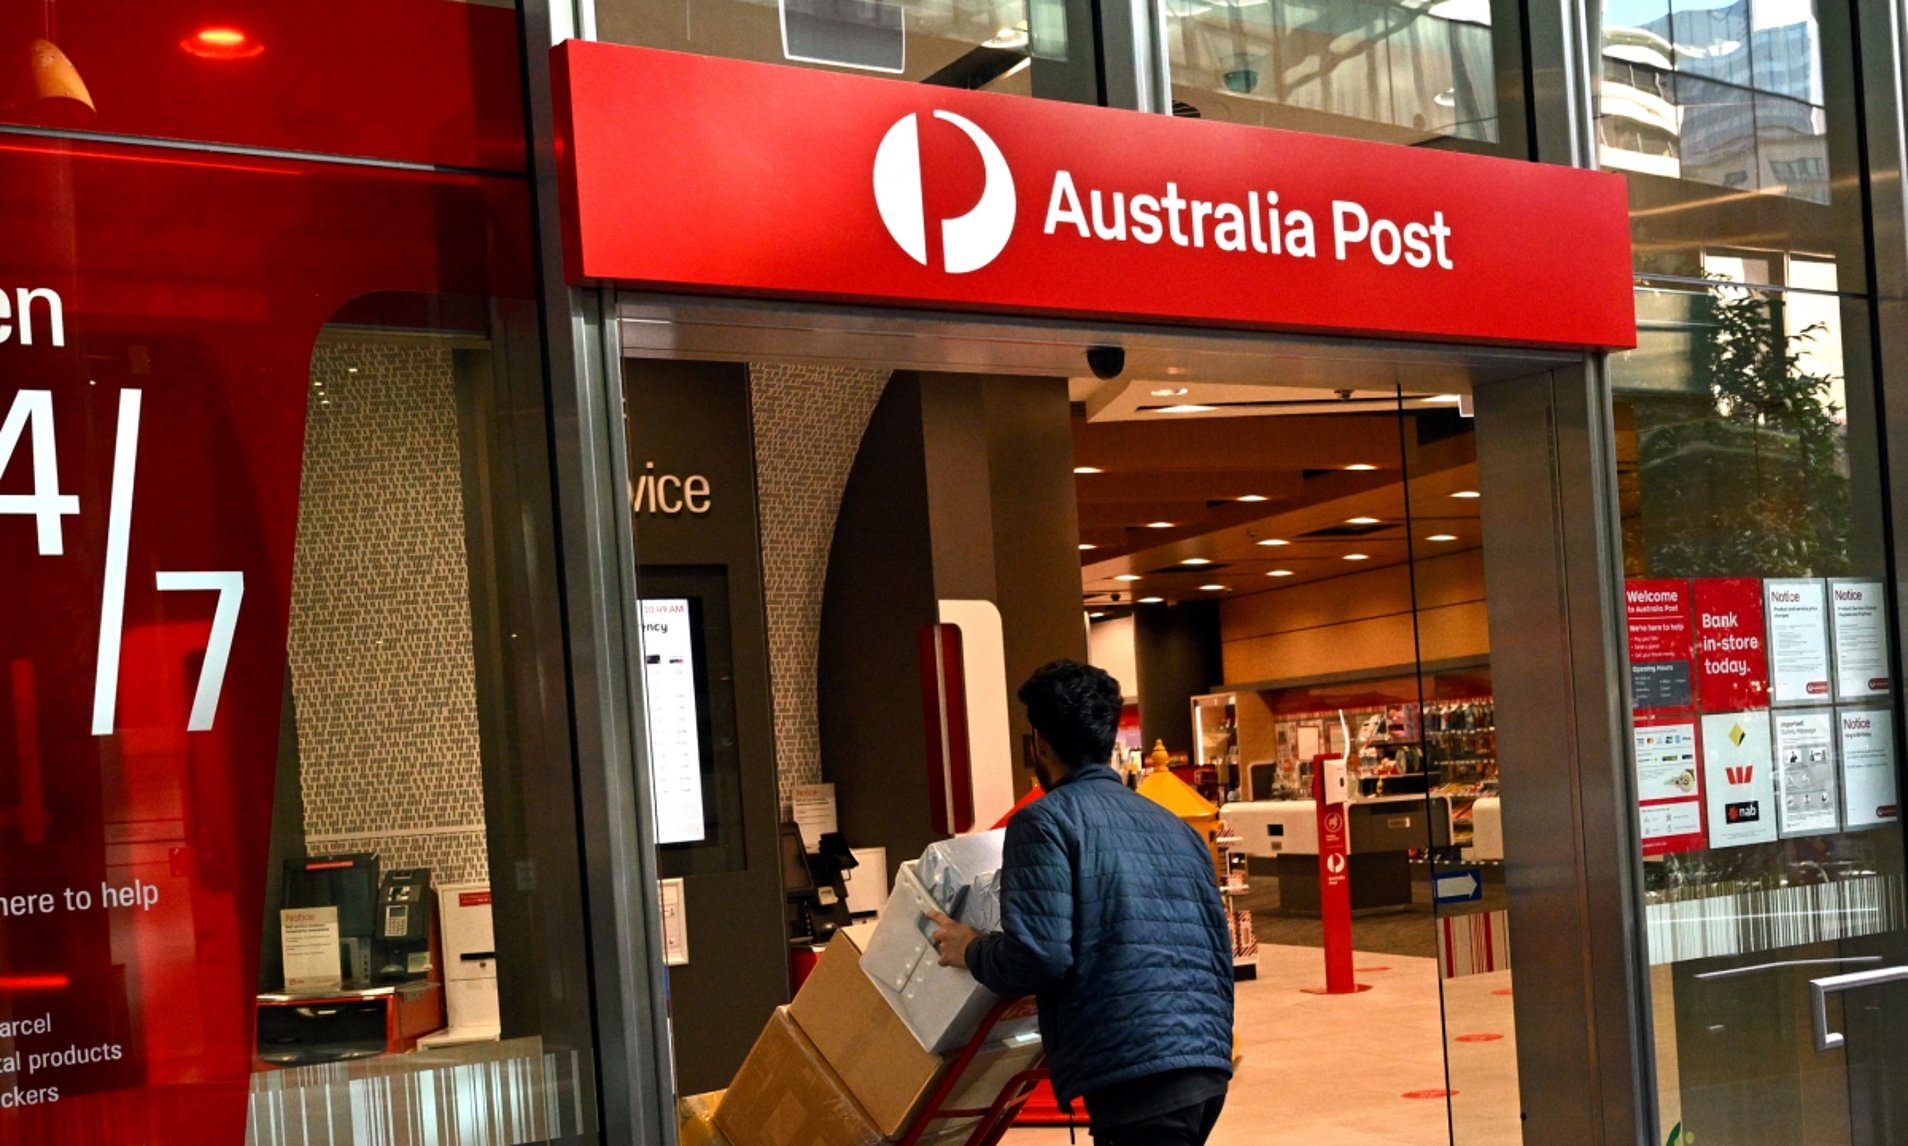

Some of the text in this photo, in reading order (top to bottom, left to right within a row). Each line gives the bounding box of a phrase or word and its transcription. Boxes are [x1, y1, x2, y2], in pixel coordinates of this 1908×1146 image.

[1043, 170, 1454, 270] Australia Post
[0, 287, 65, 347] n
[1626, 591, 1678, 602] Welcome
[1771, 590, 1800, 602] Notice
[1834, 588, 1863, 601] Notice
[669, 604, 684, 614] AM
[1628, 605, 1635, 613] to
[1702, 611, 1738, 628] Bank
[1703, 634, 1758, 651] in-store
[1704, 657, 1751, 676] today.
[1843, 718, 1871, 730] Notice
[1739, 805, 1756, 817] nab
[63, 886, 92, 912] to
[101, 879, 159, 912] help
[28, 1043, 123, 1075] products
[1, 1086, 60, 1108] ckers
